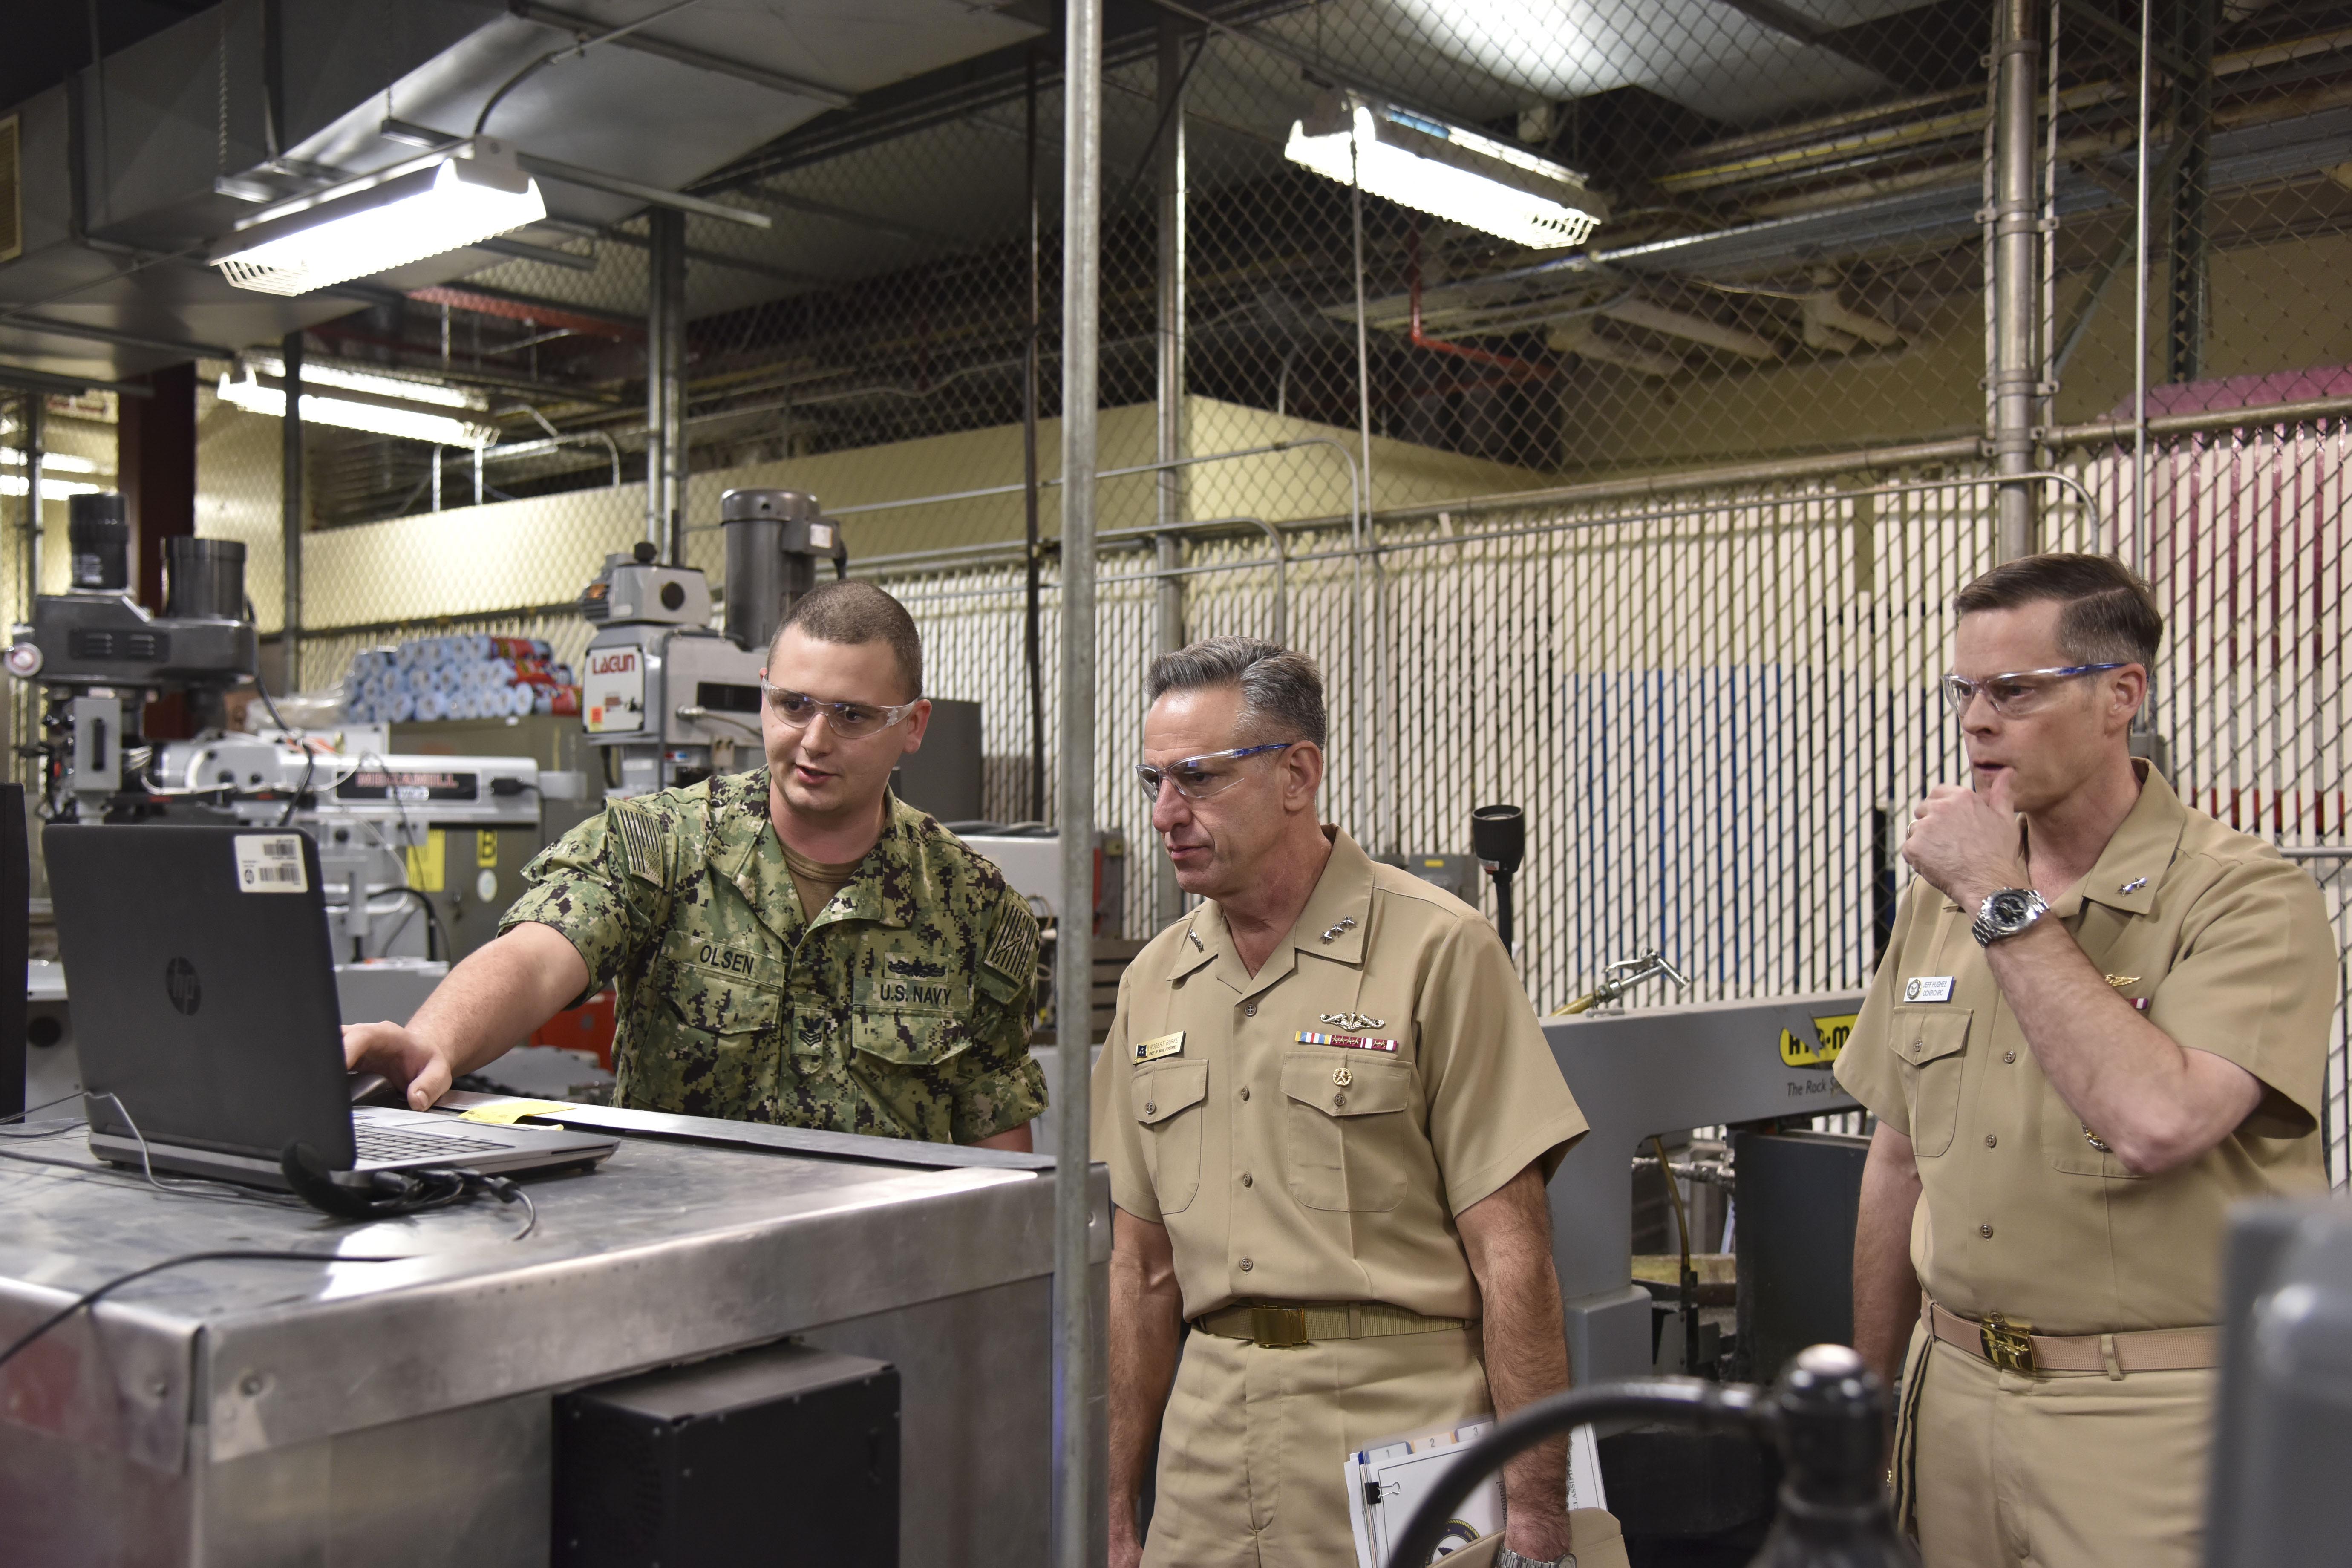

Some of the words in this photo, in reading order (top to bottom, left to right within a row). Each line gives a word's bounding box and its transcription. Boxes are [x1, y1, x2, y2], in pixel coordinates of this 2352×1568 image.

[700, 945, 754, 975] OLSEN
[880, 984, 908, 1002] U.S.
[913, 986, 952, 1005] NAVY
[1150, 1041, 1165, 1050] ROBERT
[1166, 1037, 1179, 1046] BURKE
[1787, 1082, 1802, 1097] The
[1805, 1078, 1826, 1095] Rock
[1473, 1427, 1479, 1436] 3
[1430, 1438, 1435, 1448] 2
[1386, 1449, 1390, 1458] 1
